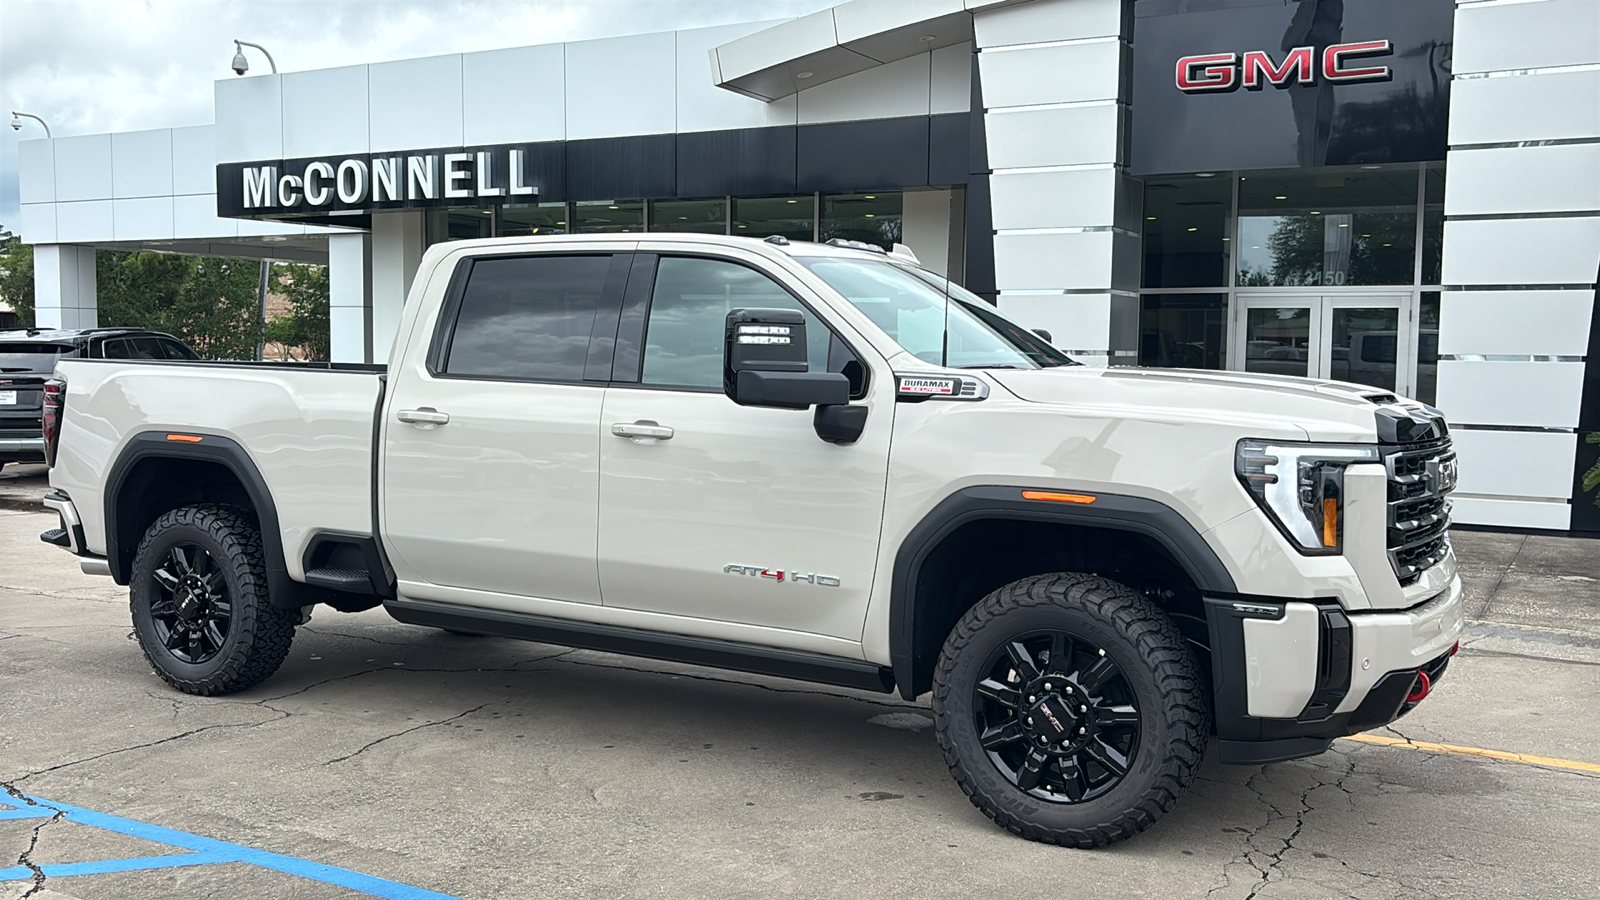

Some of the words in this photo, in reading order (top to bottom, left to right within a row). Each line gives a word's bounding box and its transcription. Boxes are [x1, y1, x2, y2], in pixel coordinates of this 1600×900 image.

[1175, 39, 1390, 91] GMC
[242, 149, 538, 208] McCONNELL
[1304, 270, 1345, 286] 3150
[904, 379, 950, 388] DURAMAX
[723, 562, 785, 583] AT4
[791, 570, 841, 587] HD
